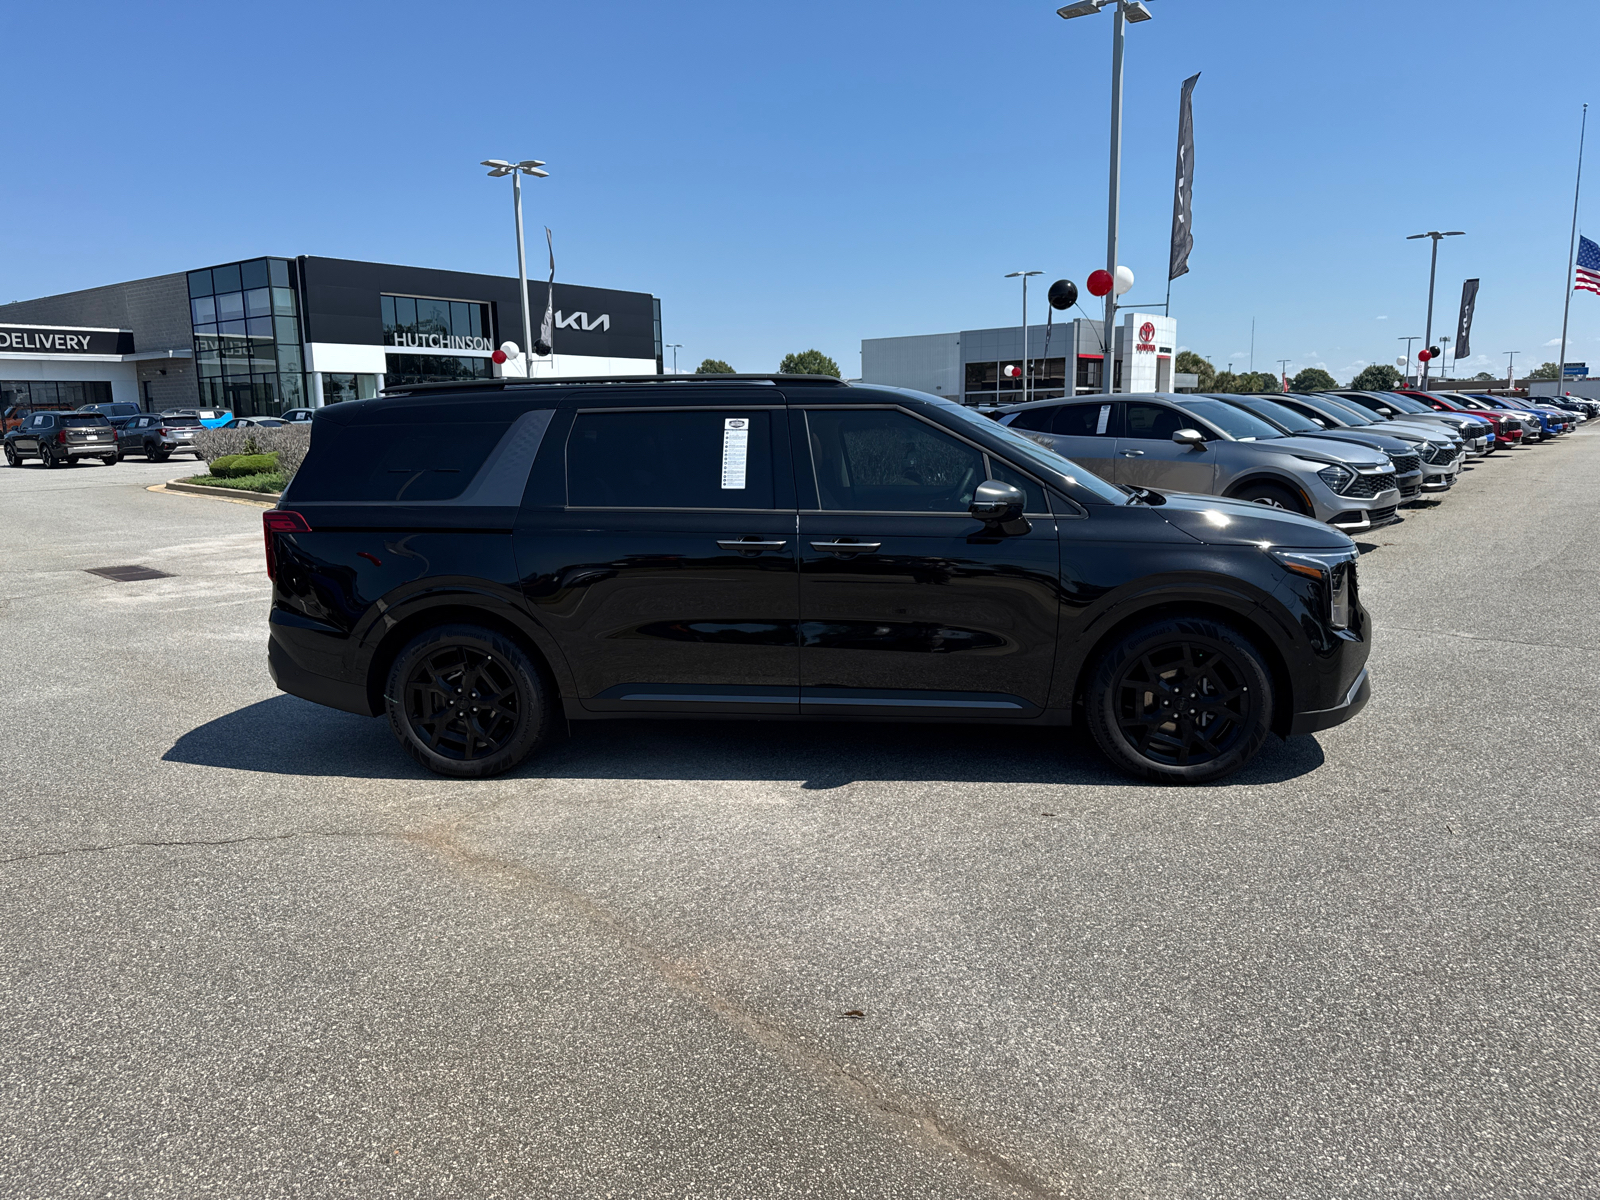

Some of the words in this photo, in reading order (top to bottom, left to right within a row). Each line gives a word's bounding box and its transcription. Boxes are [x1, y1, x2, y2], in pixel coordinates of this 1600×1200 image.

[554, 309, 610, 332] KIA
[0, 332, 91, 350] DELIVERY
[394, 332, 493, 351] HUTCHINSON
